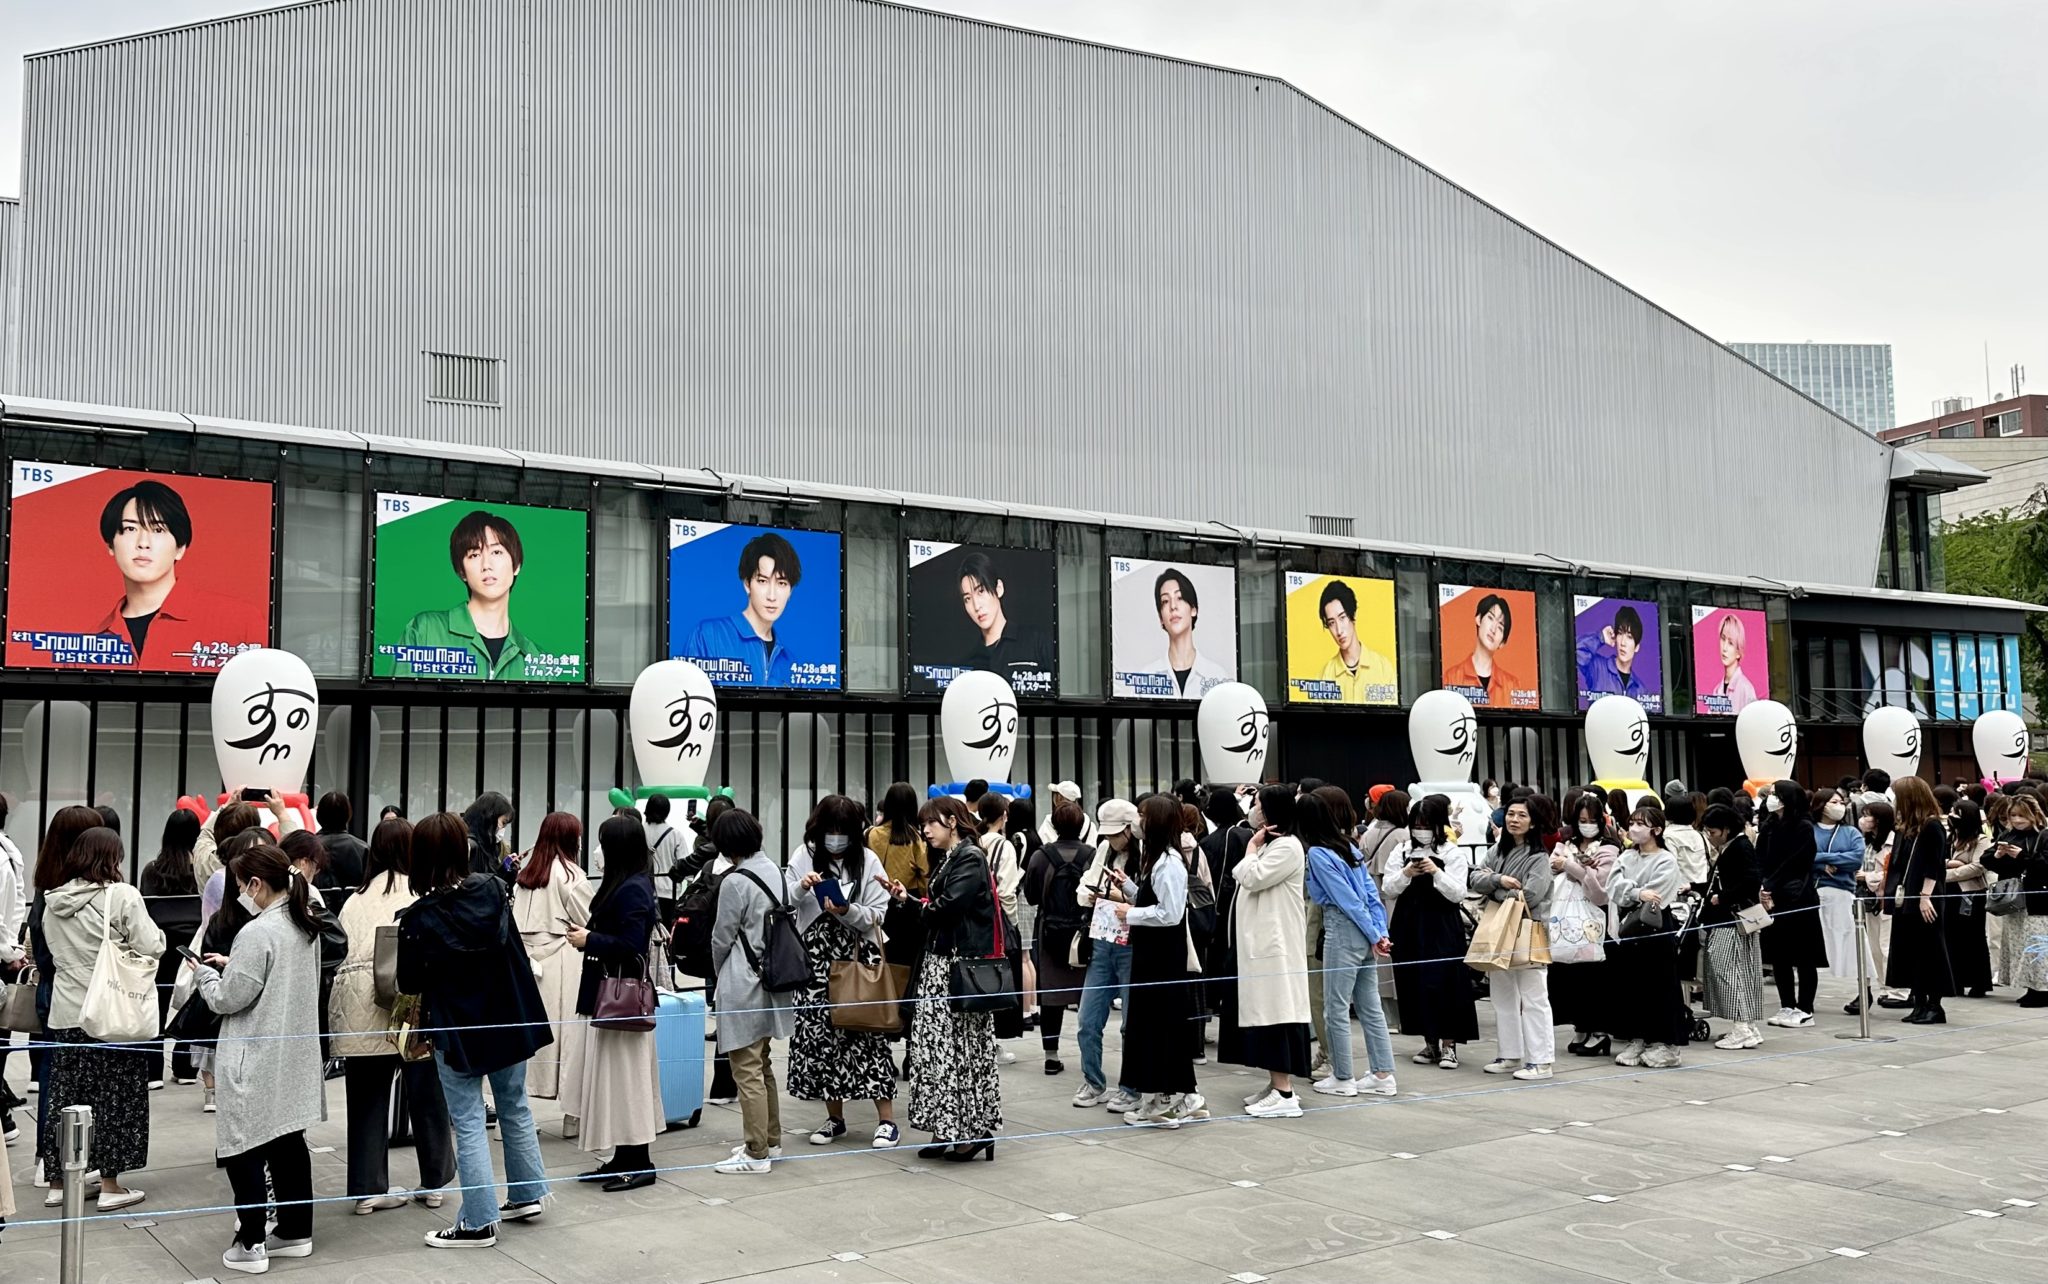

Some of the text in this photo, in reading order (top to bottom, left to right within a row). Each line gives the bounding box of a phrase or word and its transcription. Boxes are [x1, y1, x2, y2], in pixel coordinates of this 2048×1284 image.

[20, 467, 54, 483] TBS
[383, 499, 410, 513] TBS
[675, 524, 697, 537] TBS
[914, 545, 932, 556] TBS
[1115, 561, 1130, 572] TBS
[1289, 575, 1303, 585] TBS
[1442, 587, 1455, 597] TBS
[1576, 598, 1588, 607] TBS
[34, 633, 81, 651] Snow
[82, 635, 118, 652] Man
[55, 652, 133, 665] やらせて下さい
[397, 646, 434, 662] Snow
[436, 648, 464, 664] Man
[524, 653, 581, 666] 4月28日金曜
[414, 663, 477, 674] やらせて下さい
[719, 658, 742, 672] Man
[705, 672, 752, 682] らせて下さい
